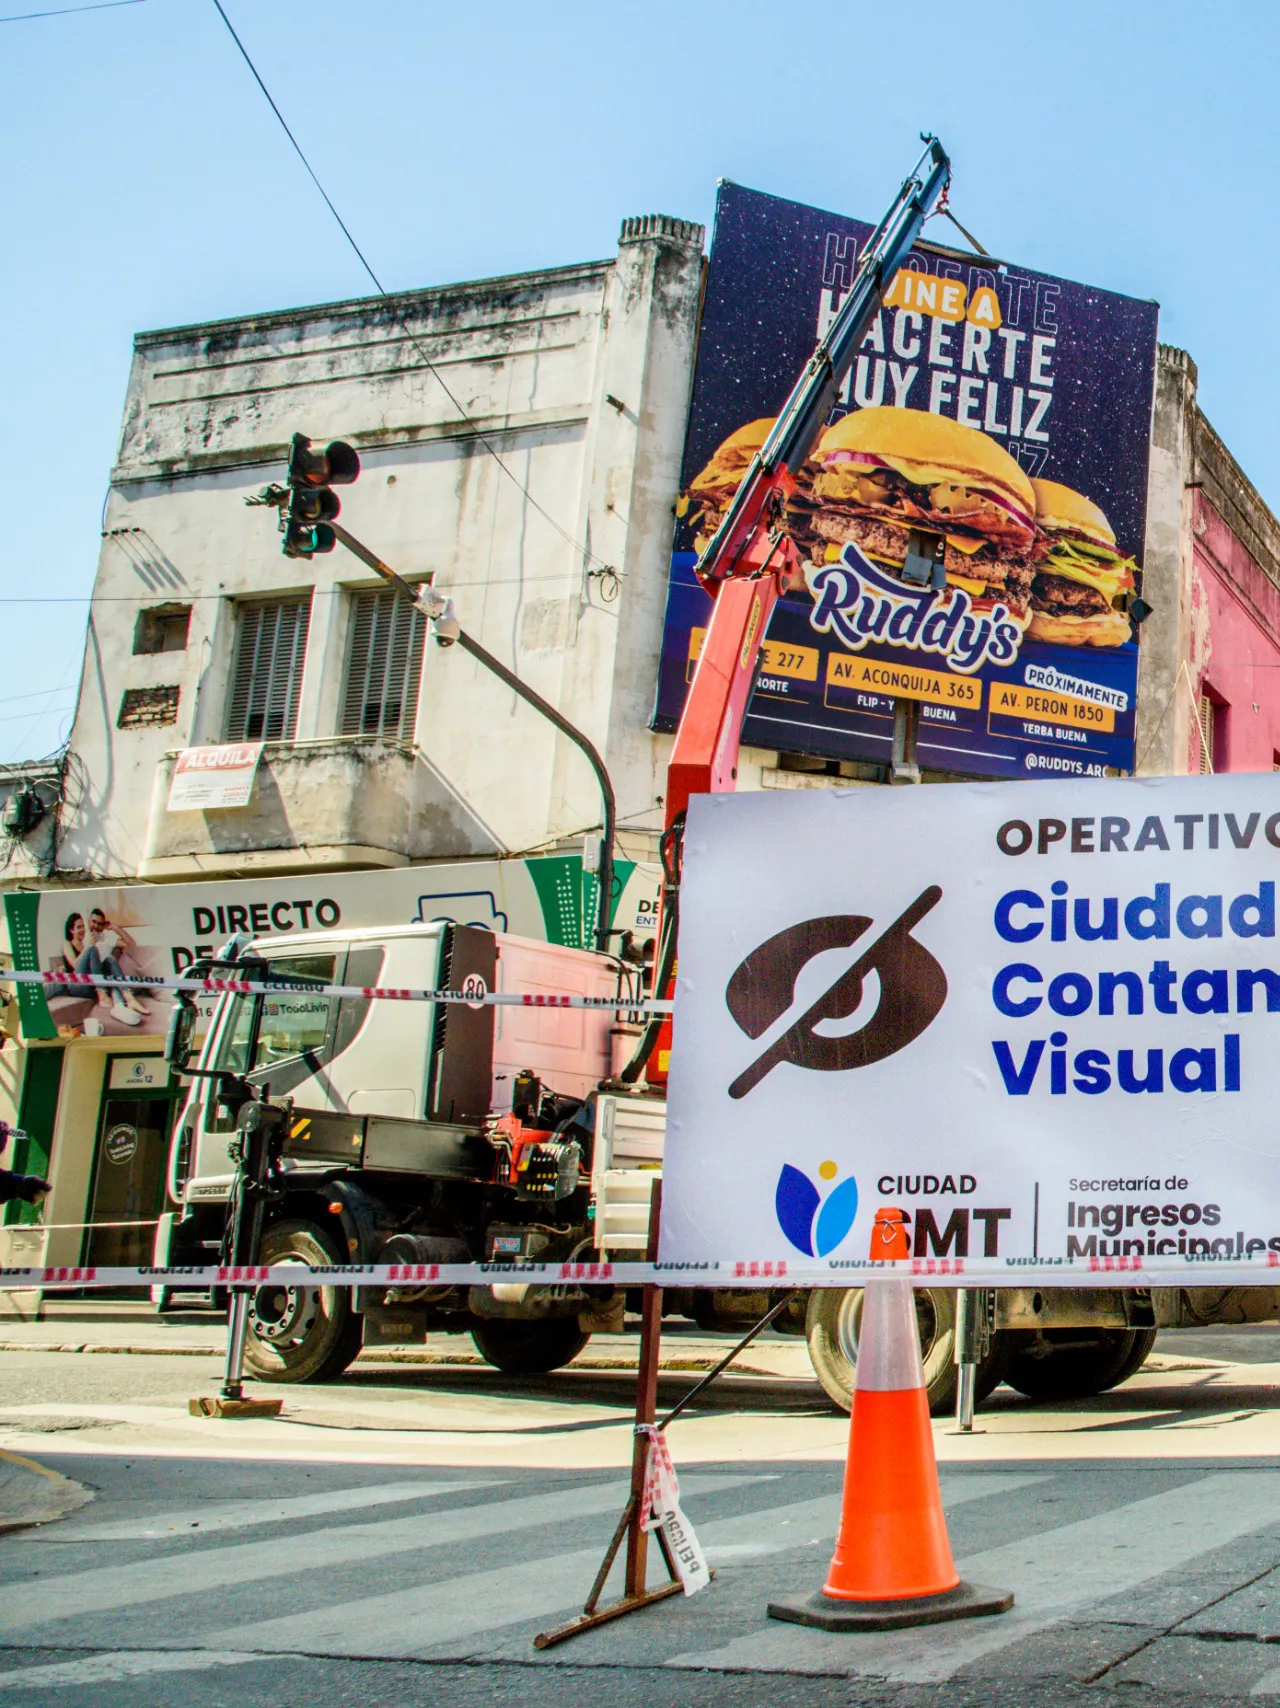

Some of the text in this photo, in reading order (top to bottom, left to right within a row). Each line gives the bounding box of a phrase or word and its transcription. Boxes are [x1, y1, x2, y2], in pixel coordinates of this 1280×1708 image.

[975, 294, 995, 322] A
[929, 369, 1054, 443] FELIZ
[810, 542, 1023, 673] Ruddy's
[777, 651, 805, 670] 277
[834, 661, 975, 700] AV. ACONQUIJA 365
[1028, 668, 1126, 708] PRÓXIMAMENTE
[857, 694, 879, 708] FLIP
[922, 705, 957, 722] BUENA
[1000, 691, 1105, 722] AV. PERON 1850
[1022, 722, 1088, 743] YERBA BUENA
[191, 897, 342, 936] DIRECTO
[993, 879, 1277, 944] Ciudad
[466, 978, 485, 1000] 80
[991, 1030, 1242, 1096] Visual
[877, 1174, 978, 1195] CIUDAD
[1068, 1175, 1189, 1192] Secretaría de
[899, 1207, 1012, 1258] MT
[1067, 1201, 1222, 1237] Ingresos
